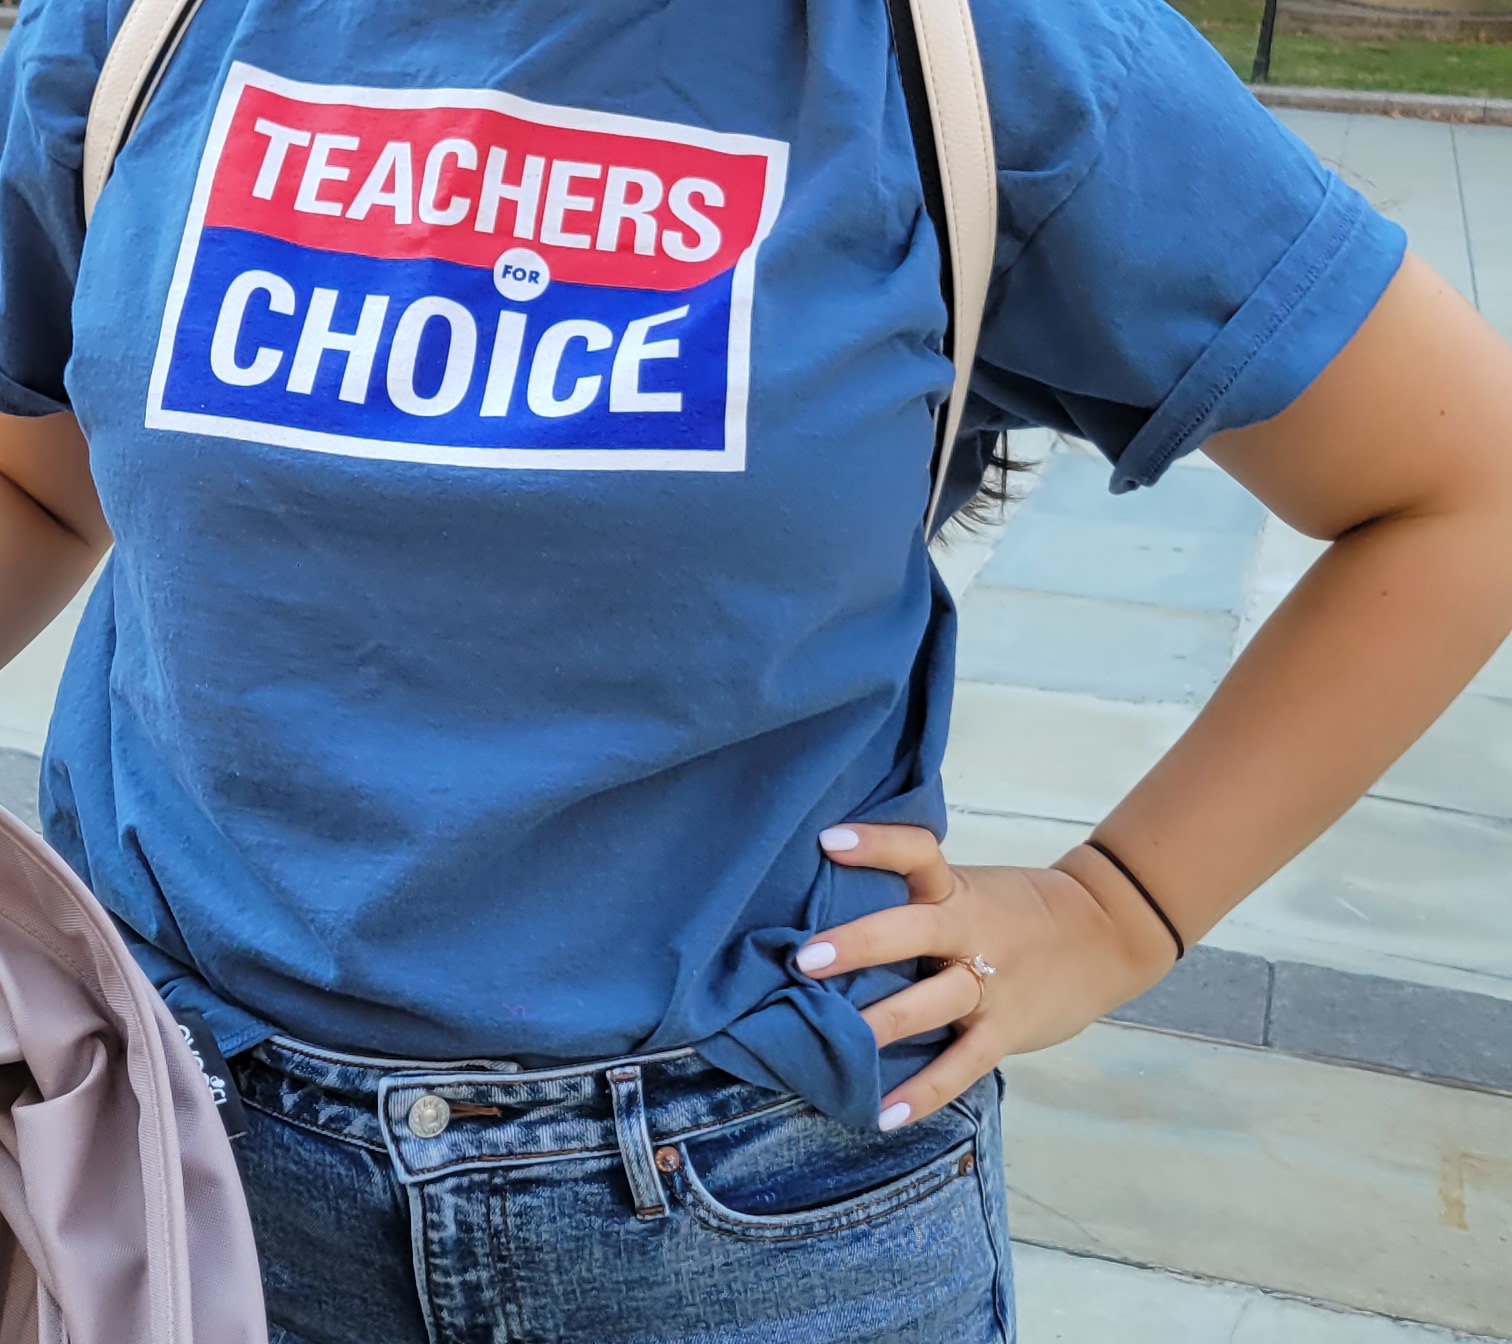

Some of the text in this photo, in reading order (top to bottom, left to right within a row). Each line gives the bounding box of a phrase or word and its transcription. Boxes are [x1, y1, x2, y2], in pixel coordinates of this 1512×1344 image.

[250, 117, 726, 263] TEACHERS
[208, 269, 690, 419] CHOICE
[500, 263, 541, 285] FOR
